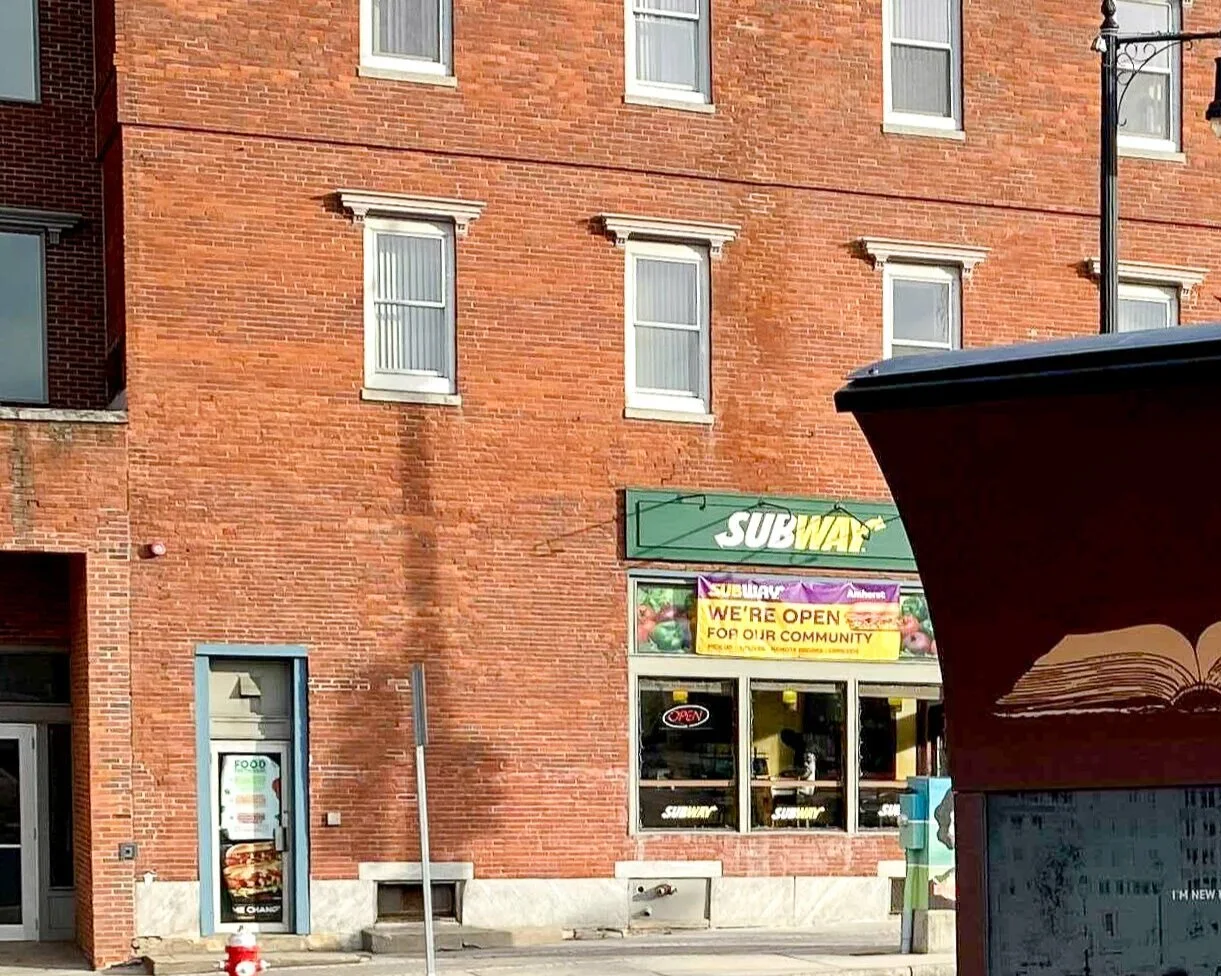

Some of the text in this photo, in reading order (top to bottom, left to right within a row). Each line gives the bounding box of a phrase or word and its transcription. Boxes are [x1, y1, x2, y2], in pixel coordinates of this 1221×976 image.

[714, 511, 887, 553] SUBWAY
[708, 583, 785, 600] SUBWAY
[708, 604, 840, 626] WE'RE OPEN
[707, 627, 873, 645] FOR OUR COMMUNITY
[667, 710, 704, 722] OPEN
[234, 759, 267, 769] FOOD
[661, 805, 718, 818] SUBWAY
[771, 807, 826, 820] SUBWAY
[1191, 889, 1216, 900] NEW
